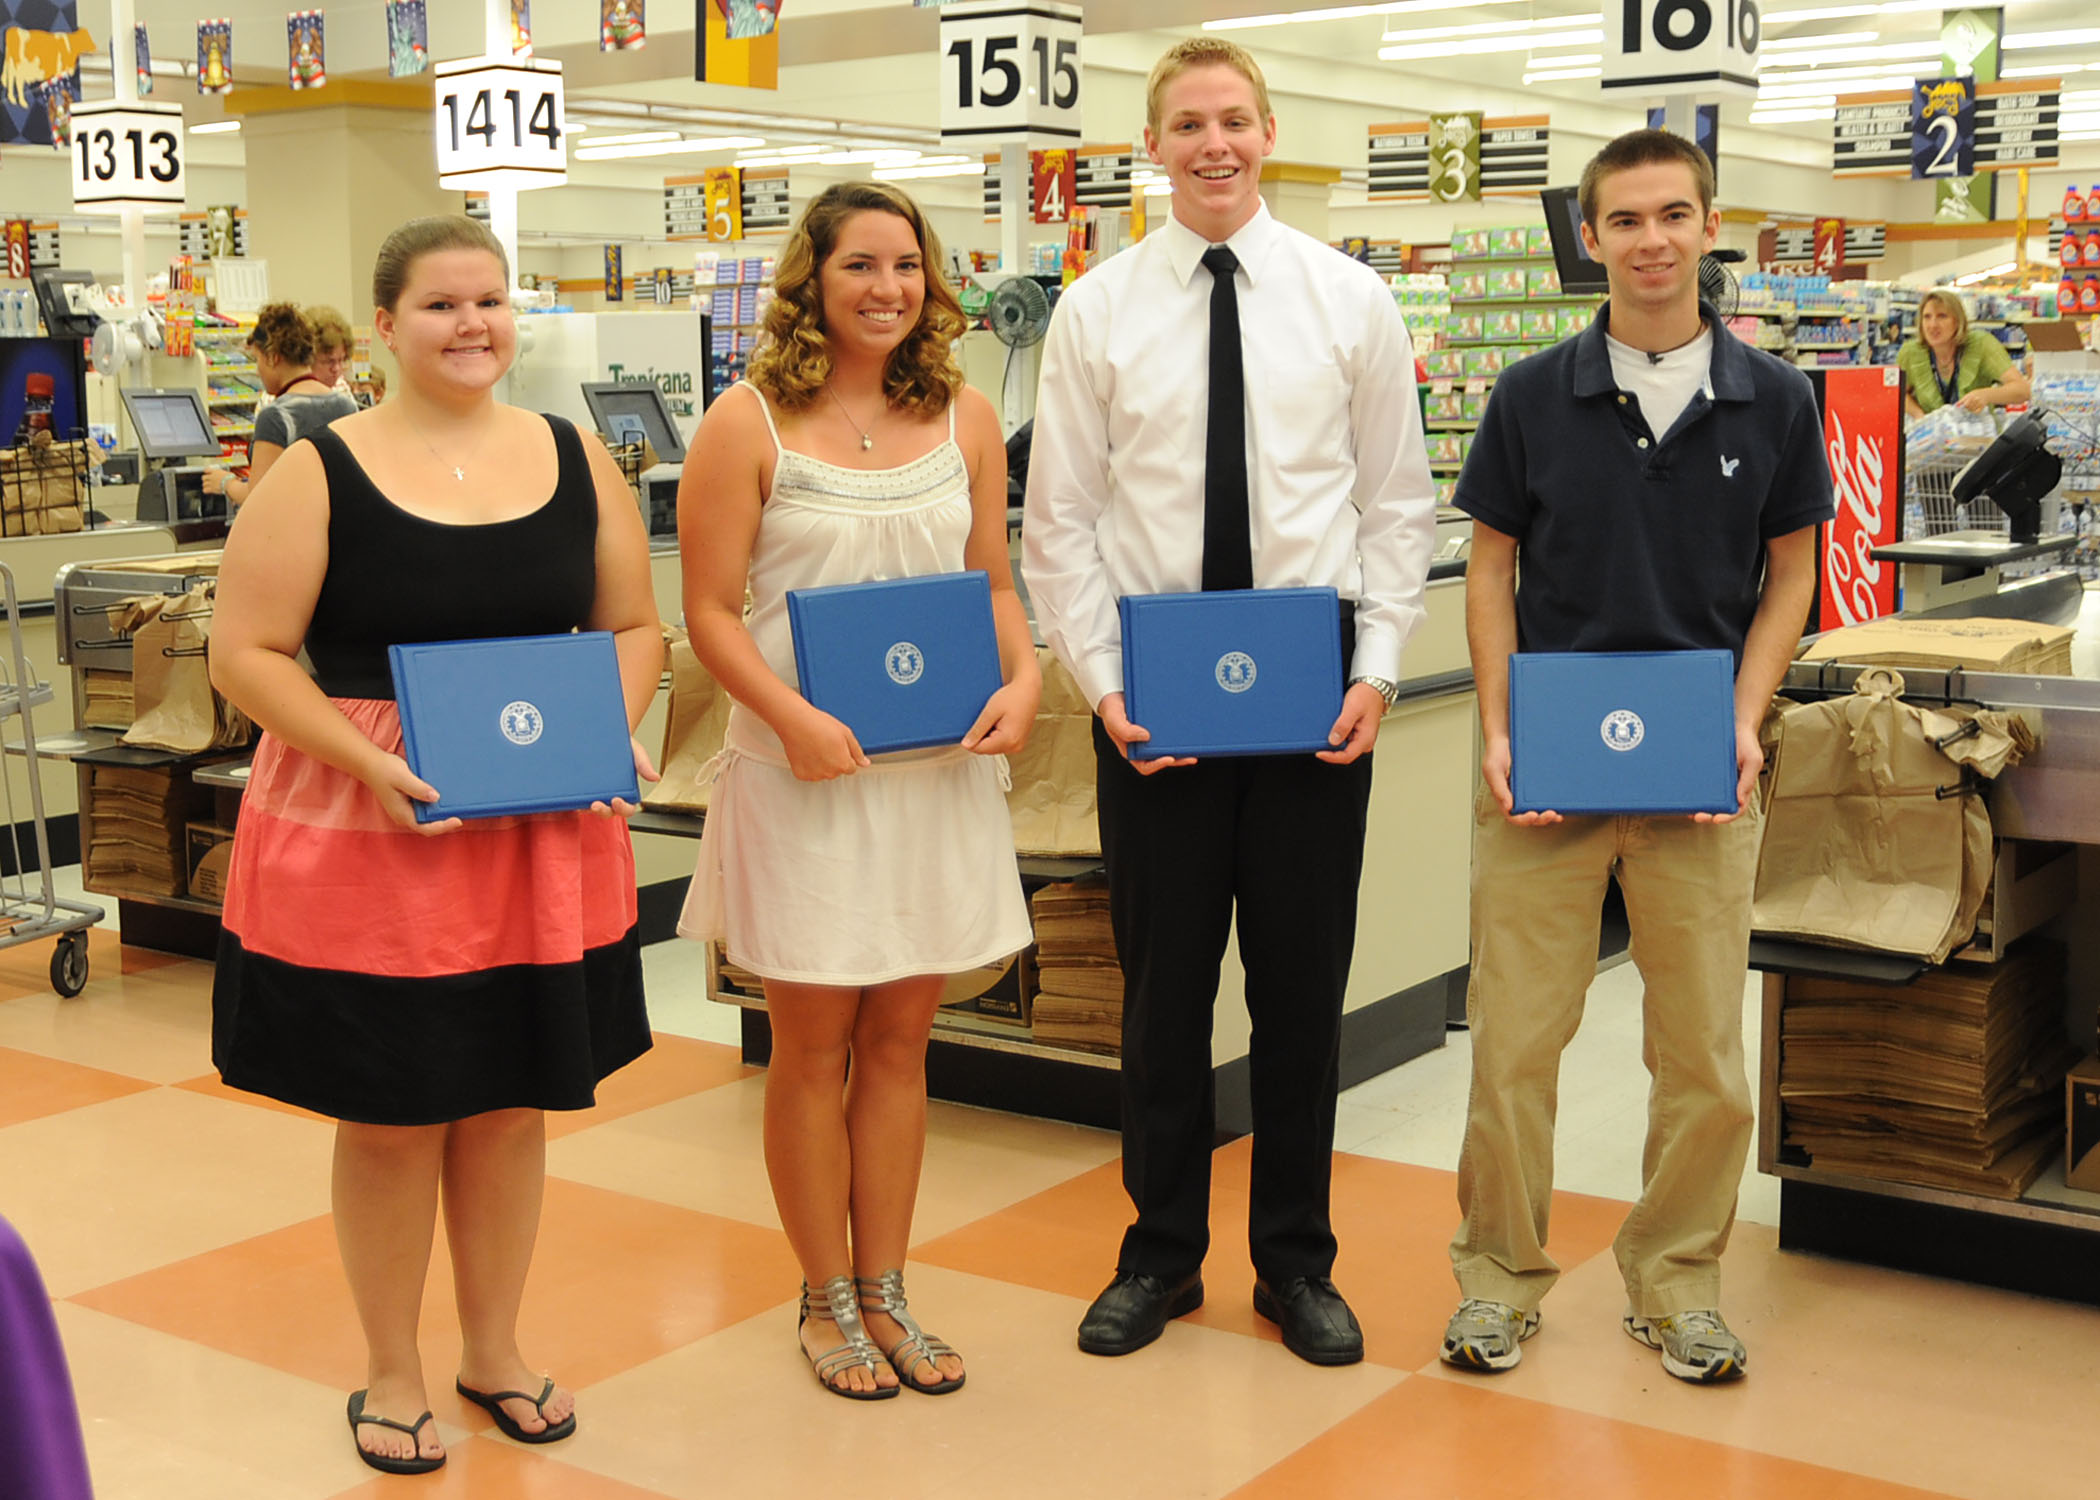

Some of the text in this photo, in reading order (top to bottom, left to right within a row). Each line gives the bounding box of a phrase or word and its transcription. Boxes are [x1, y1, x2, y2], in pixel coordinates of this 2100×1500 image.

[947, 35, 1021, 108] 15
[1032, 36, 1079, 109] 15
[442, 88, 496, 151] 14
[504, 89, 561, 150] 14
[1924, 115, 1959, 176] 2
[75, 128, 116, 181] 13
[125, 129, 180, 182] 13
[1440, 148, 1467, 201] 3
[713, 194, 732, 240] 5
[1041, 172, 1065, 221] 4
[10, 242, 25, 278] 8
[1819, 236, 1837, 267] 4
[655, 281, 671, 304] 10
